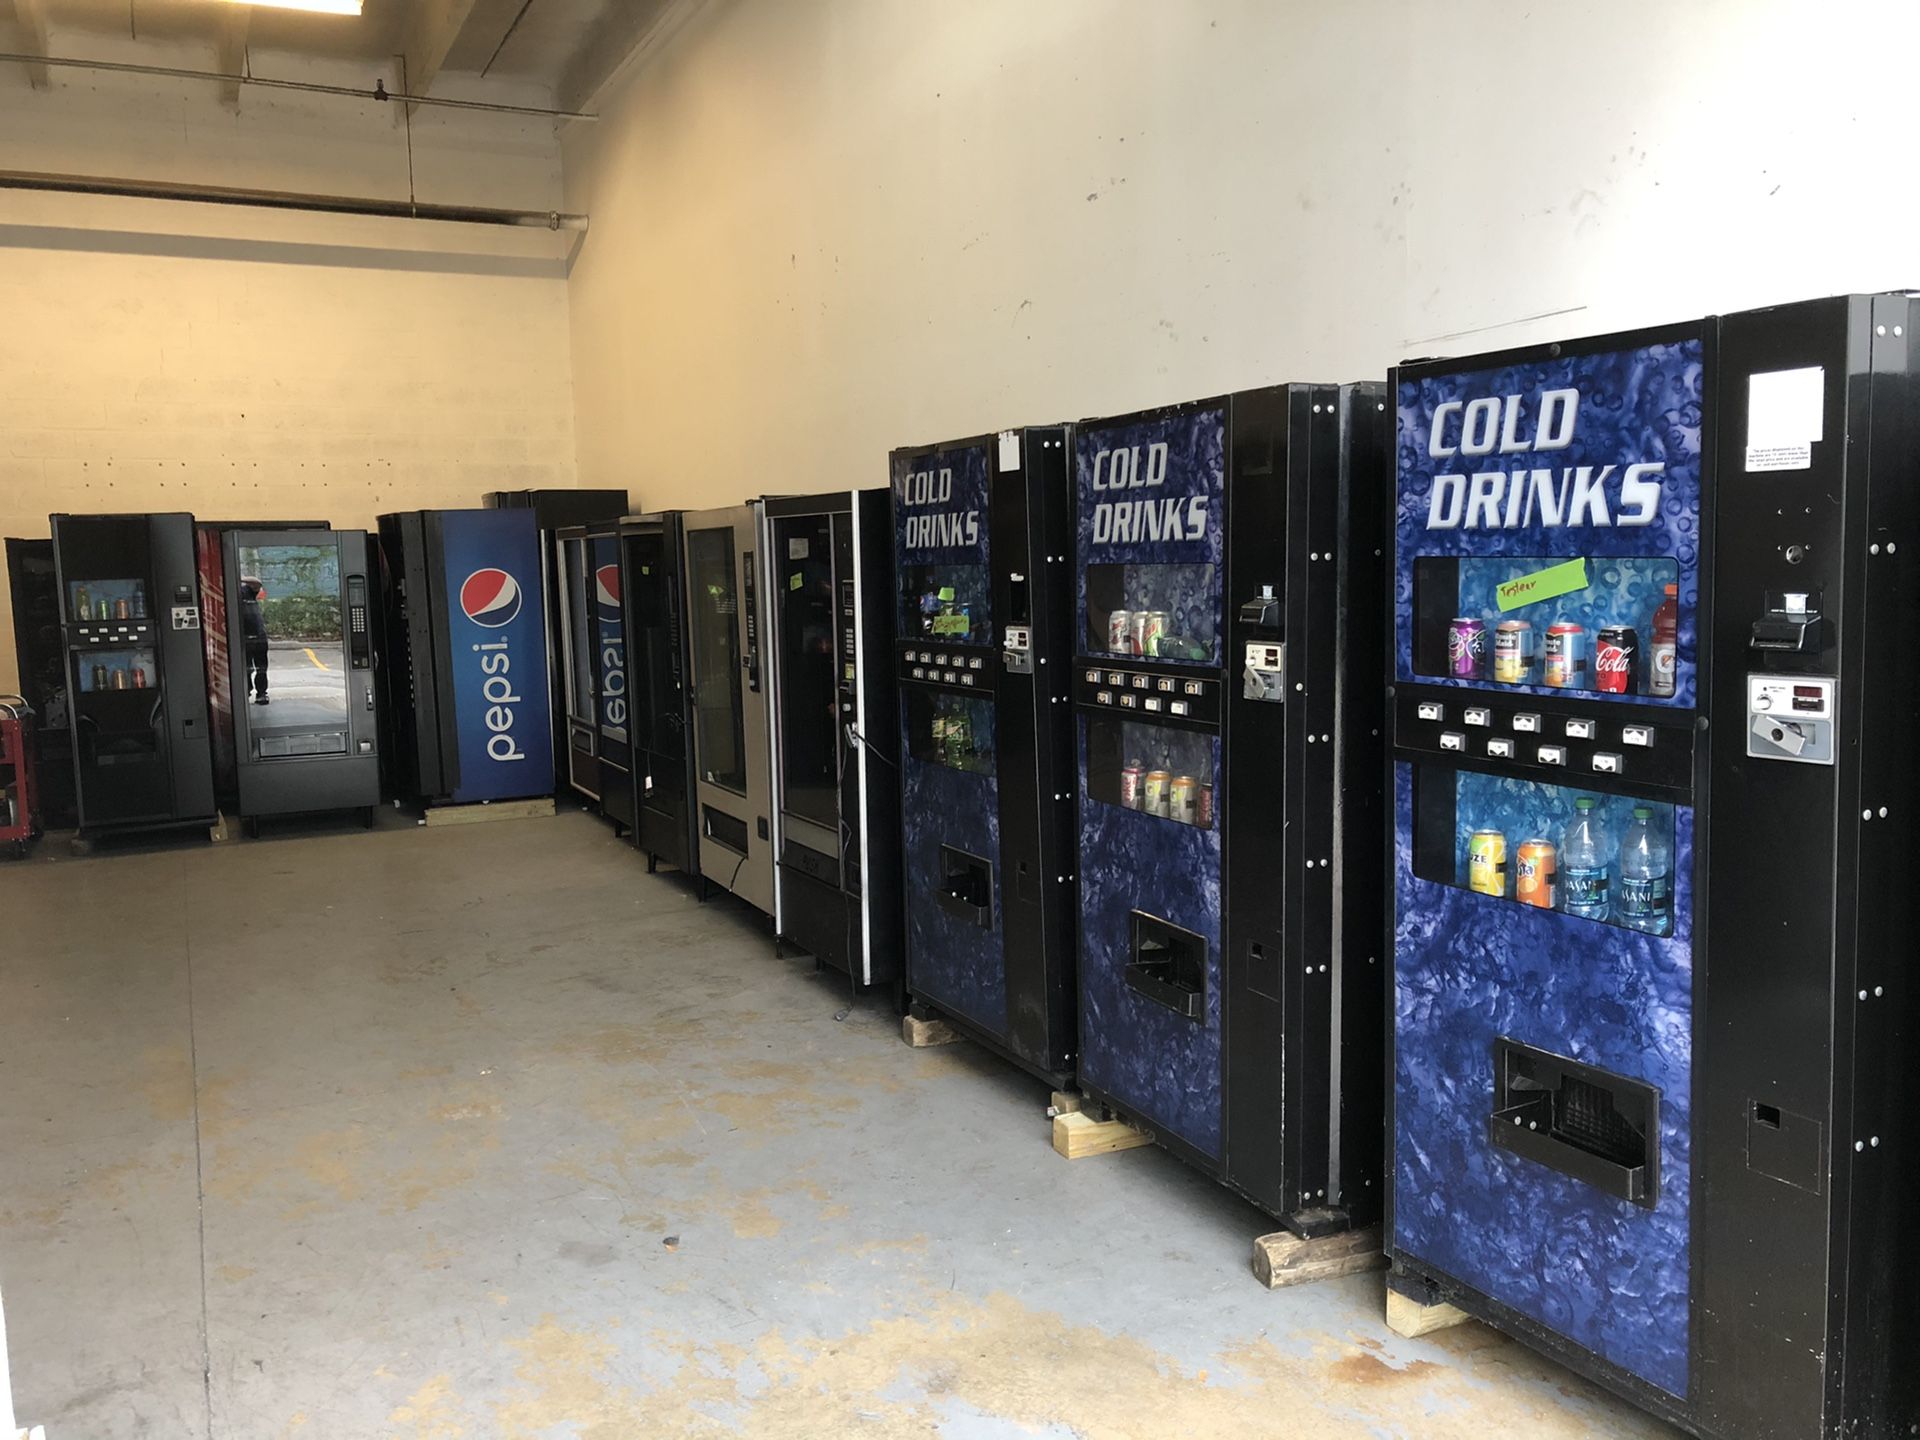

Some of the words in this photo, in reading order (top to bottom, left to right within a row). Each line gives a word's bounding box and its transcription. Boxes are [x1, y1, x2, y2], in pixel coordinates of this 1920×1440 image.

[1428, 387, 1580, 457] COLD
[904, 468, 952, 506] COLD
[1092, 442, 1168, 491] COLD
[1092, 495, 1209, 545] DRINKS
[1425, 462, 1665, 530] DRINKS
[905, 510, 980, 549] DRINKS
[1595, 646, 1634, 673] Cola
[472, 642, 525, 761] pepsi
